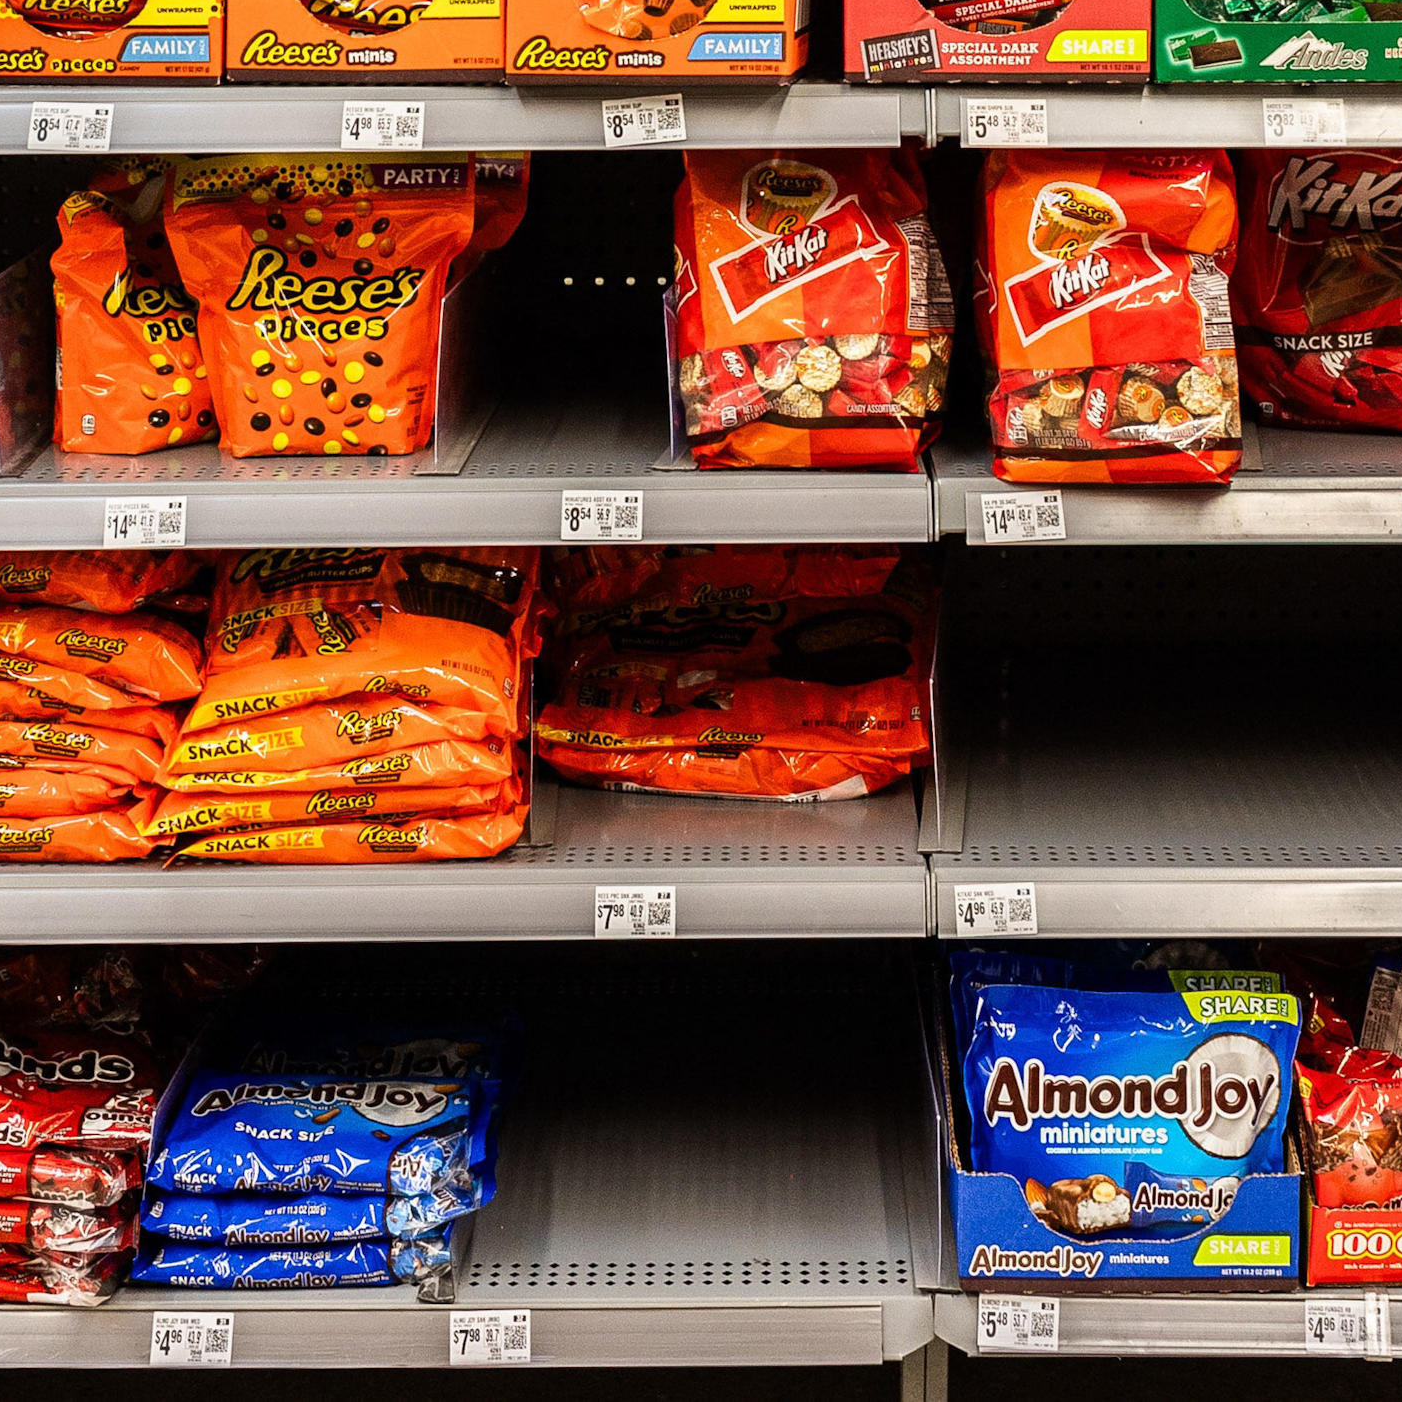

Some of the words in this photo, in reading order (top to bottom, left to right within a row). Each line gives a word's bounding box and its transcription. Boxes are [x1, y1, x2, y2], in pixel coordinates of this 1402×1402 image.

[131, 38, 196, 57] FAMILY
[942, 43, 997, 56] SPECIAL
[1000, 43, 1038, 54] DARK
[1289, 40, 1368, 69] Andes
[949, 54, 1032, 67] ASSORTMENT
[383, 168, 449, 185] PARTY
[228, 247, 425, 314] Reese's
[254, 314, 388, 341] pieces
[1274, 336, 1322, 352] SNACK
[1326, 331, 1373, 349] SIZE
[307, 791, 377, 815] Reese's
[205, 836, 270, 852] SNACK
[275, 832, 316, 850] SIZE
[1199, 994, 1278, 1017] SHARE
[1041, 1123, 1168, 1145] miniatures
[1329, 1231, 1393, 1257] 100
[1109, 1253, 1169, 1265] miniatures
